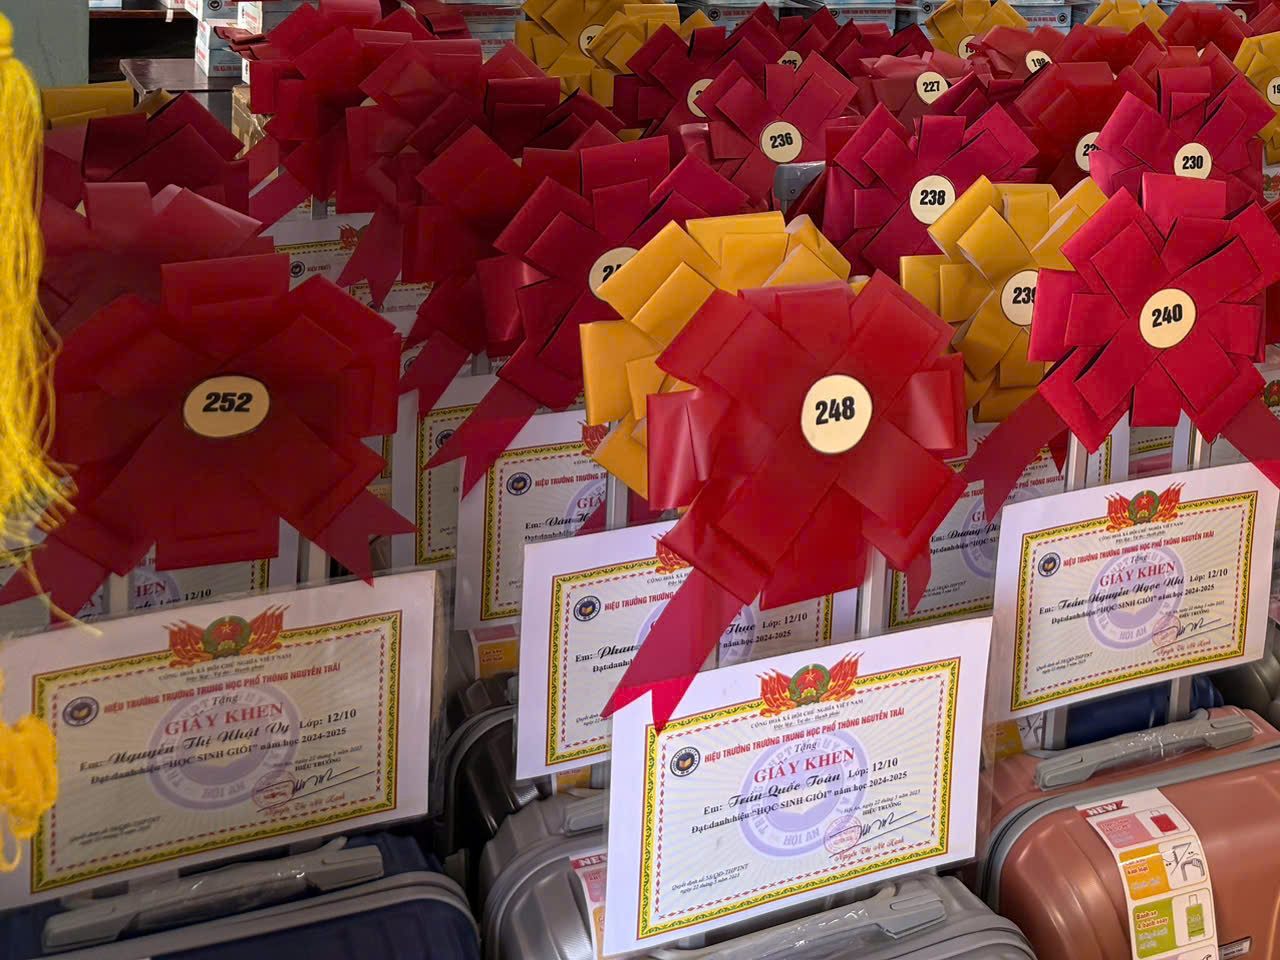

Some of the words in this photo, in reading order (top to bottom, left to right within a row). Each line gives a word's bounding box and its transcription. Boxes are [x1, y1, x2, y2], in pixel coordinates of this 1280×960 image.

[922, 80, 941, 94] 227
[769, 131, 794, 151] 236
[1181, 155, 1204, 171] 230
[919, 187, 946, 207] 238
[1151, 302, 1184, 328] 240
[201, 391, 255, 414] 252
[814, 395, 856, 426] 248
[1099, 564, 1134, 587] GIẤY
[1137, 561, 1175, 579] KHEN
[1208, 567, 1227, 580] 12/10
[184, 588, 212, 602] 12/10
[604, 600, 624, 611] HIỆU
[1117, 599, 1135, 610] SINH
[1184, 583, 1214, 596] 2024-2025
[575, 651, 593, 663] Em:
[761, 615, 782, 631] Lớp:
[783, 612, 809, 625] 12/10
[723, 640, 740, 649] năm
[740, 636, 755, 648] học
[755, 629, 792, 644] 2024-2025
[104, 700, 124, 715] HIỆU
[197, 683, 222, 695] TRUNG
[226, 679, 241, 692] HỌC
[243, 673, 259, 687] PHỔ
[262, 670, 288, 684] THÔNG
[290, 663, 321, 680] NGUYỄN
[211, 693, 238, 706] Tặng
[165, 707, 217, 736] GIẤY
[225, 701, 283, 725] KHEN
[108, 740, 174, 768] Nguyễn
[182, 733, 211, 752] Thị
[217, 723, 258, 744] Nhật
[266, 717, 289, 736] Vy
[298, 715, 323, 731] Lớp:
[327, 708, 356, 723] 12/10
[197, 748, 223, 763] SINH
[260, 739, 280, 751] năm
[283, 734, 298, 747] học
[301, 726, 346, 743] 2024-2025
[704, 749, 721, 763] HIỆU
[782, 729, 804, 742] TRUNG
[807, 726, 820, 738] HỌC
[821, 720, 836, 733] PHỔ
[838, 716, 859, 729] THÔNG
[861, 709, 887, 725] NGUYỄN
[889, 706, 904, 718] TRÃI
[793, 739, 817, 754] Tặng
[754, 754, 799, 783] GIẤY
[805, 747, 854, 771] KHEN
[703, 801, 723, 815] Em:
[728, 787, 762, 809] Trần
[767, 777, 801, 801] Quốc
[848, 764, 868, 781] Lớp:
[872, 756, 898, 772] 12/10
[780, 795, 804, 809] SINH
[833, 784, 850, 796] năm
[853, 780, 867, 792] học
[869, 770, 907, 787] 2024-2025
[1087, 803, 1118, 816] NEW
